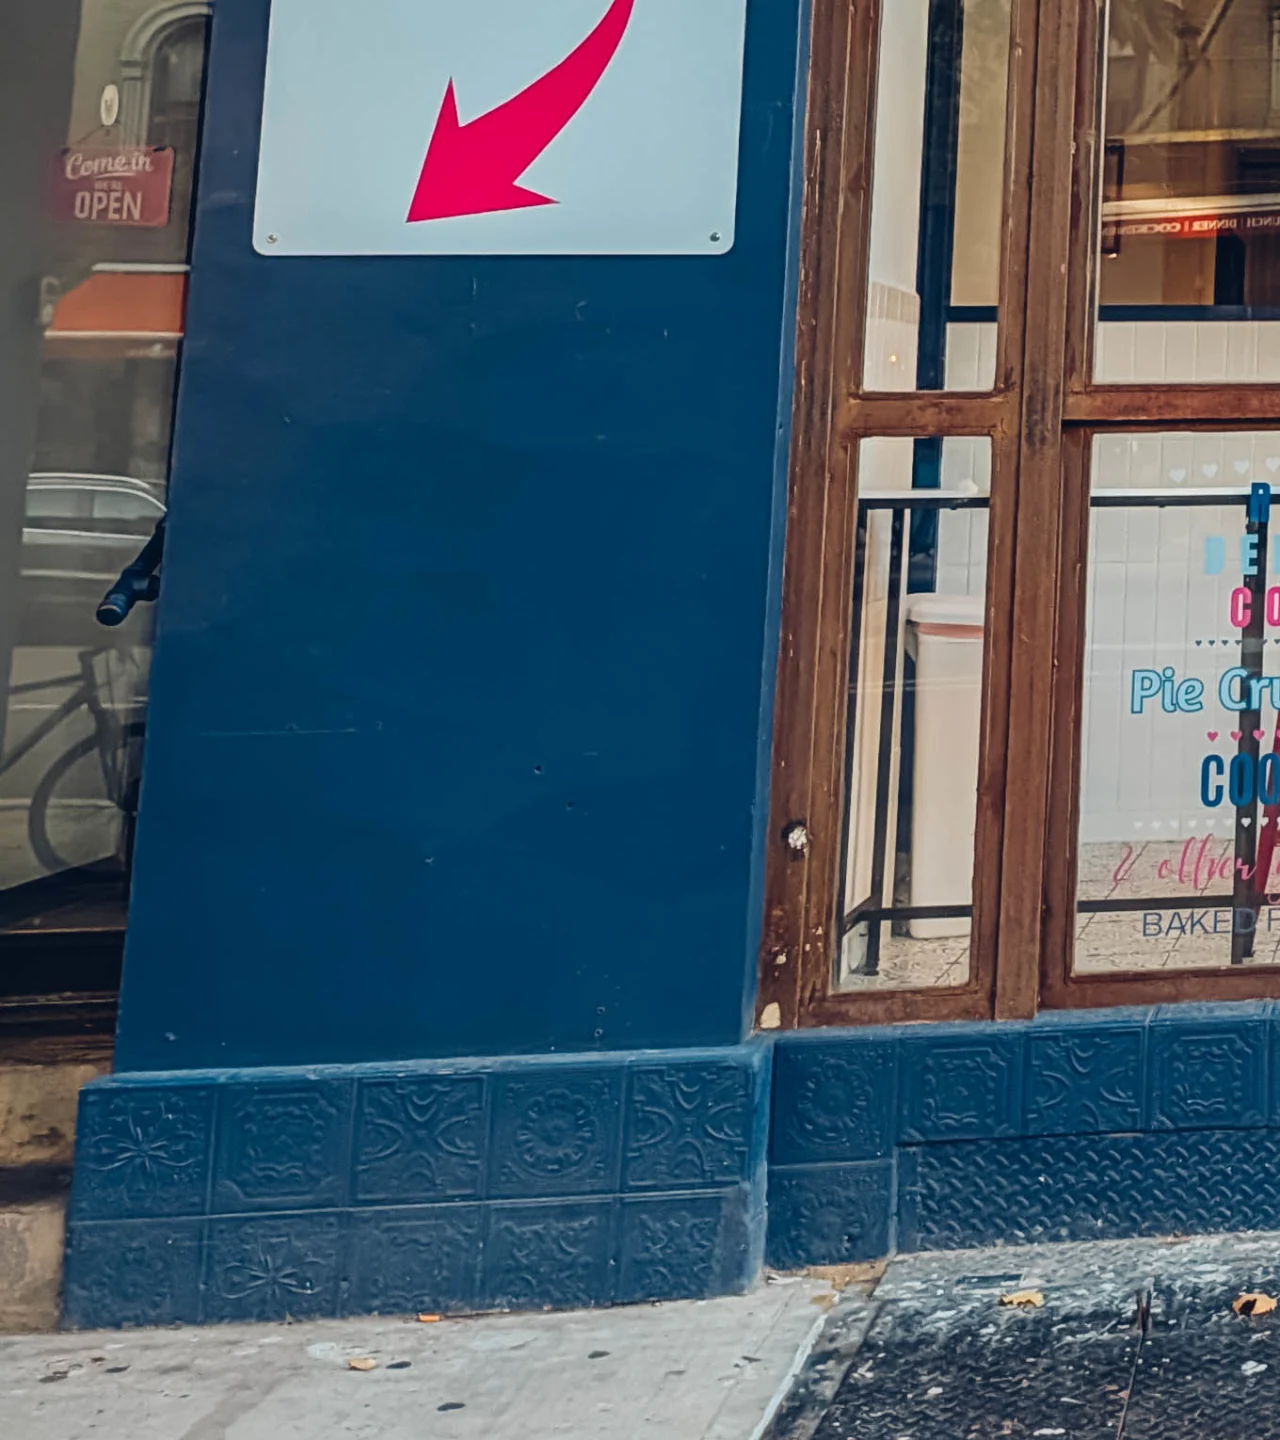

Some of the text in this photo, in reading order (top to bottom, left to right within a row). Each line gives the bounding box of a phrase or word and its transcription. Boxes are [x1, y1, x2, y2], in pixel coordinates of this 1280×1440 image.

[66, 151, 154, 180] Come in
[75, 191, 142, 220] OPEN
[1131, 666, 1204, 714] Pie
[1142, 906, 1258, 937] BAKED
